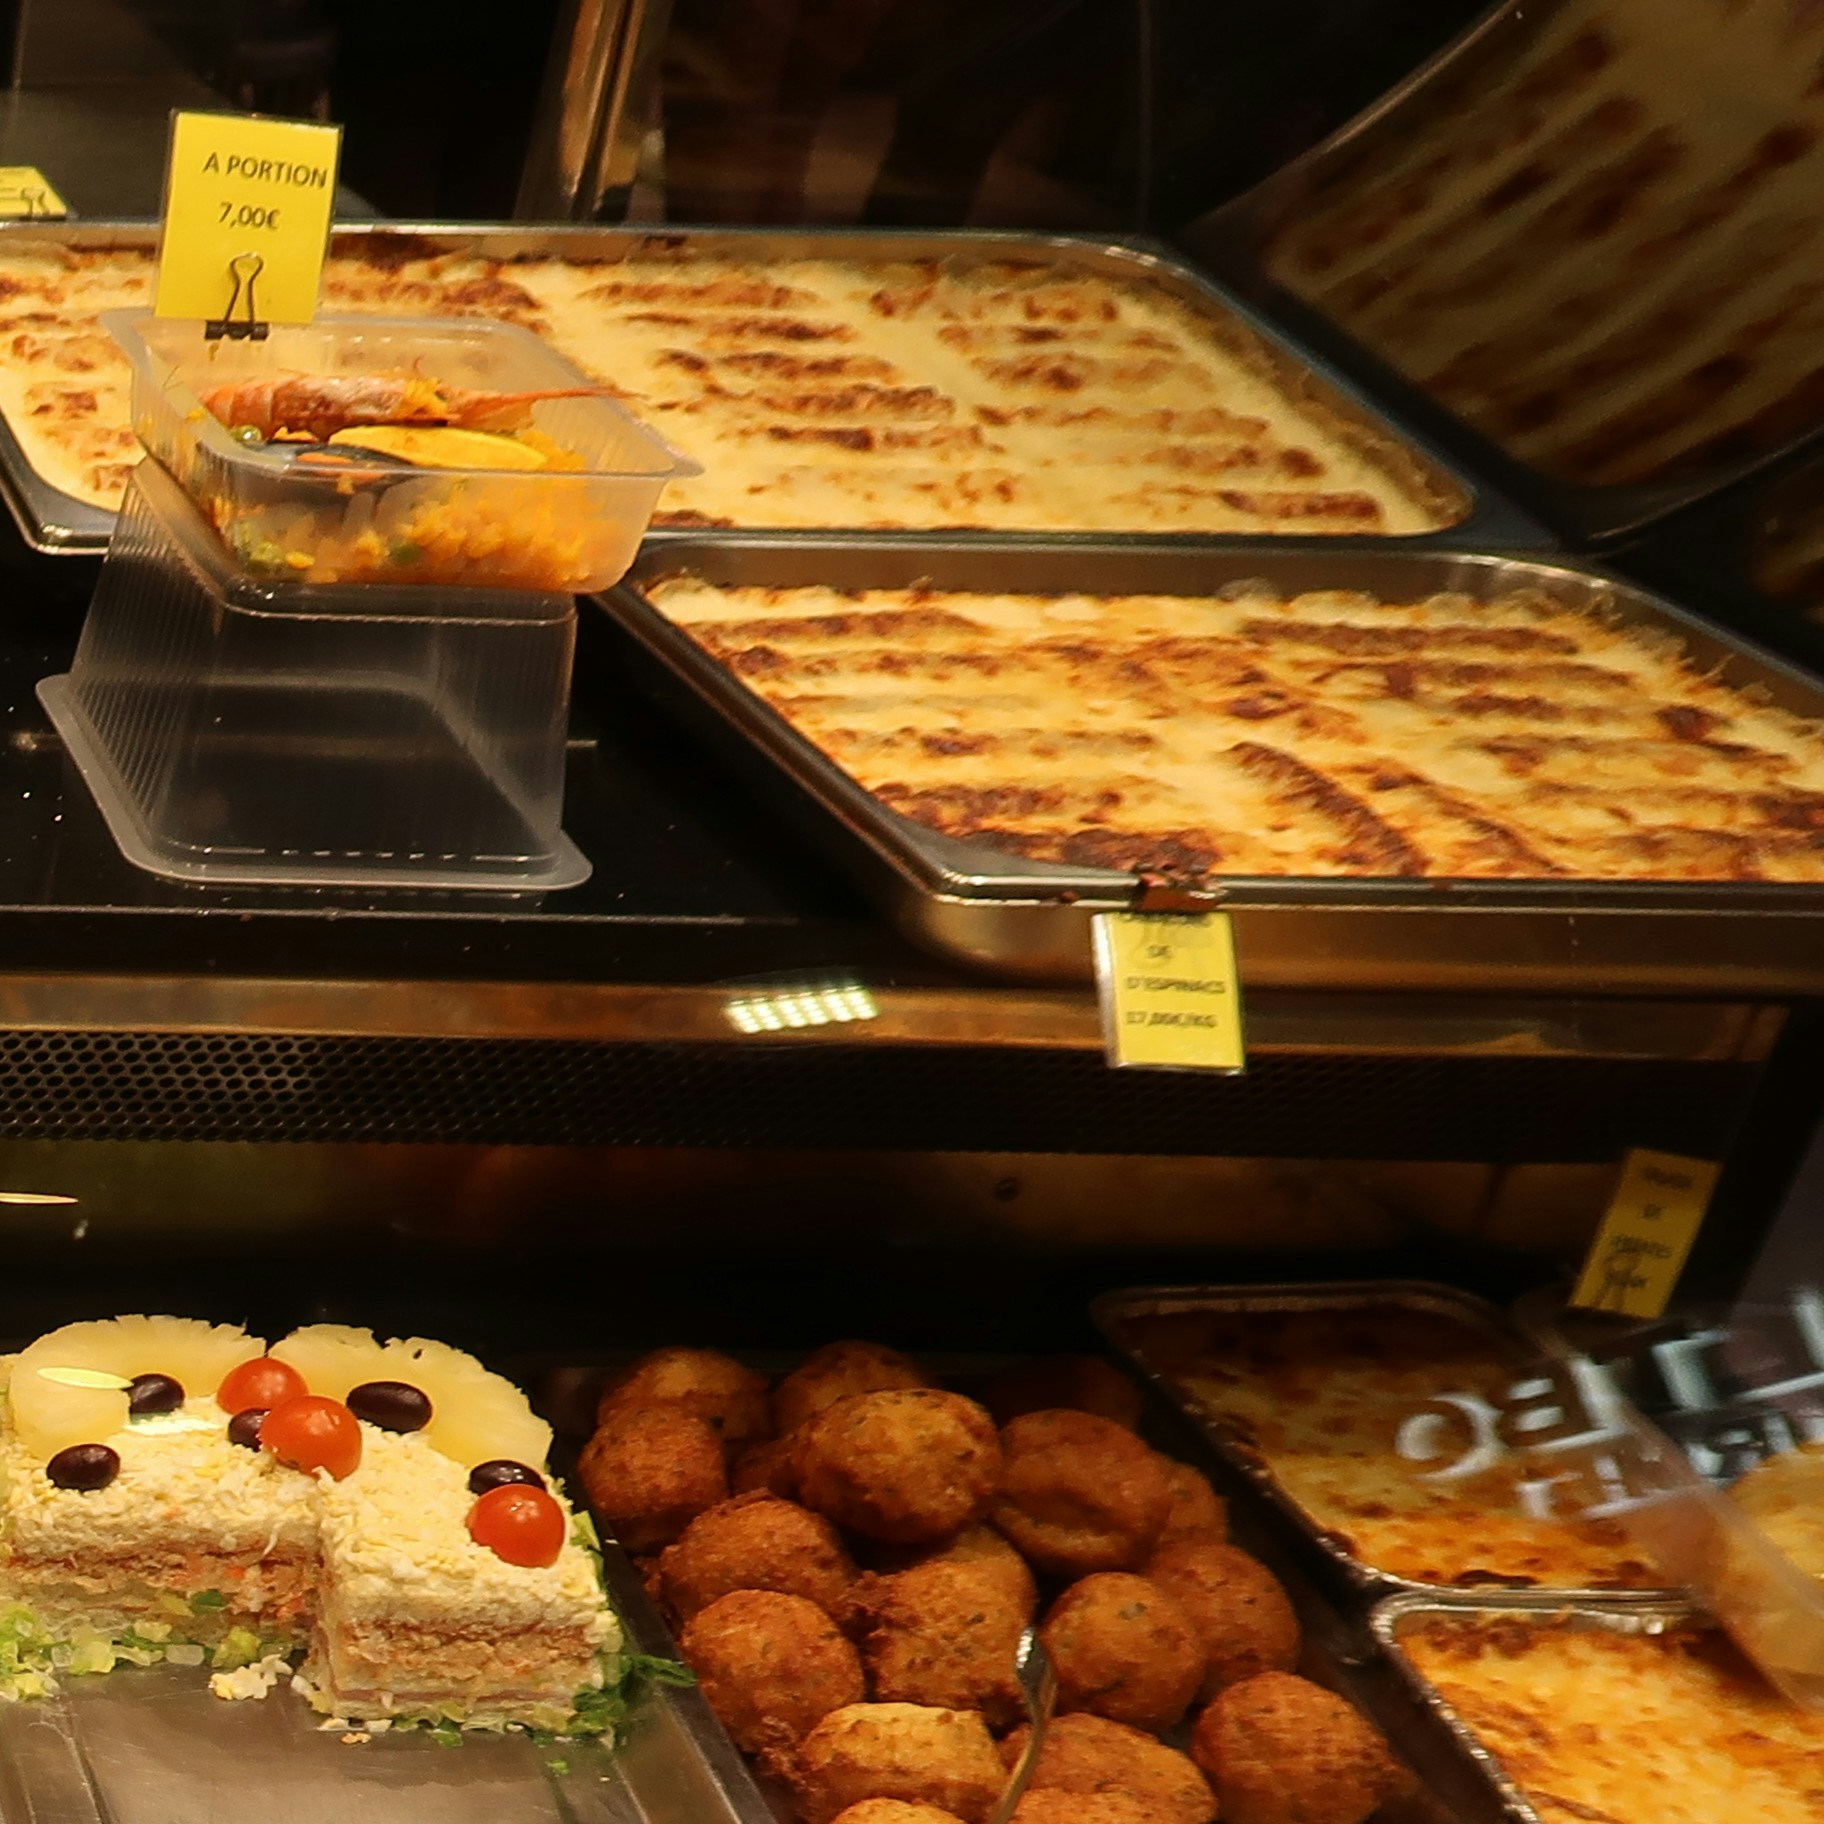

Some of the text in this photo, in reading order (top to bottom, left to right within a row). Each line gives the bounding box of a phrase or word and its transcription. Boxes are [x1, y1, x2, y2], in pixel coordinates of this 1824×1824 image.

[202, 152, 328, 189] A PORTION
[217, 202, 281, 230] 7,00€
